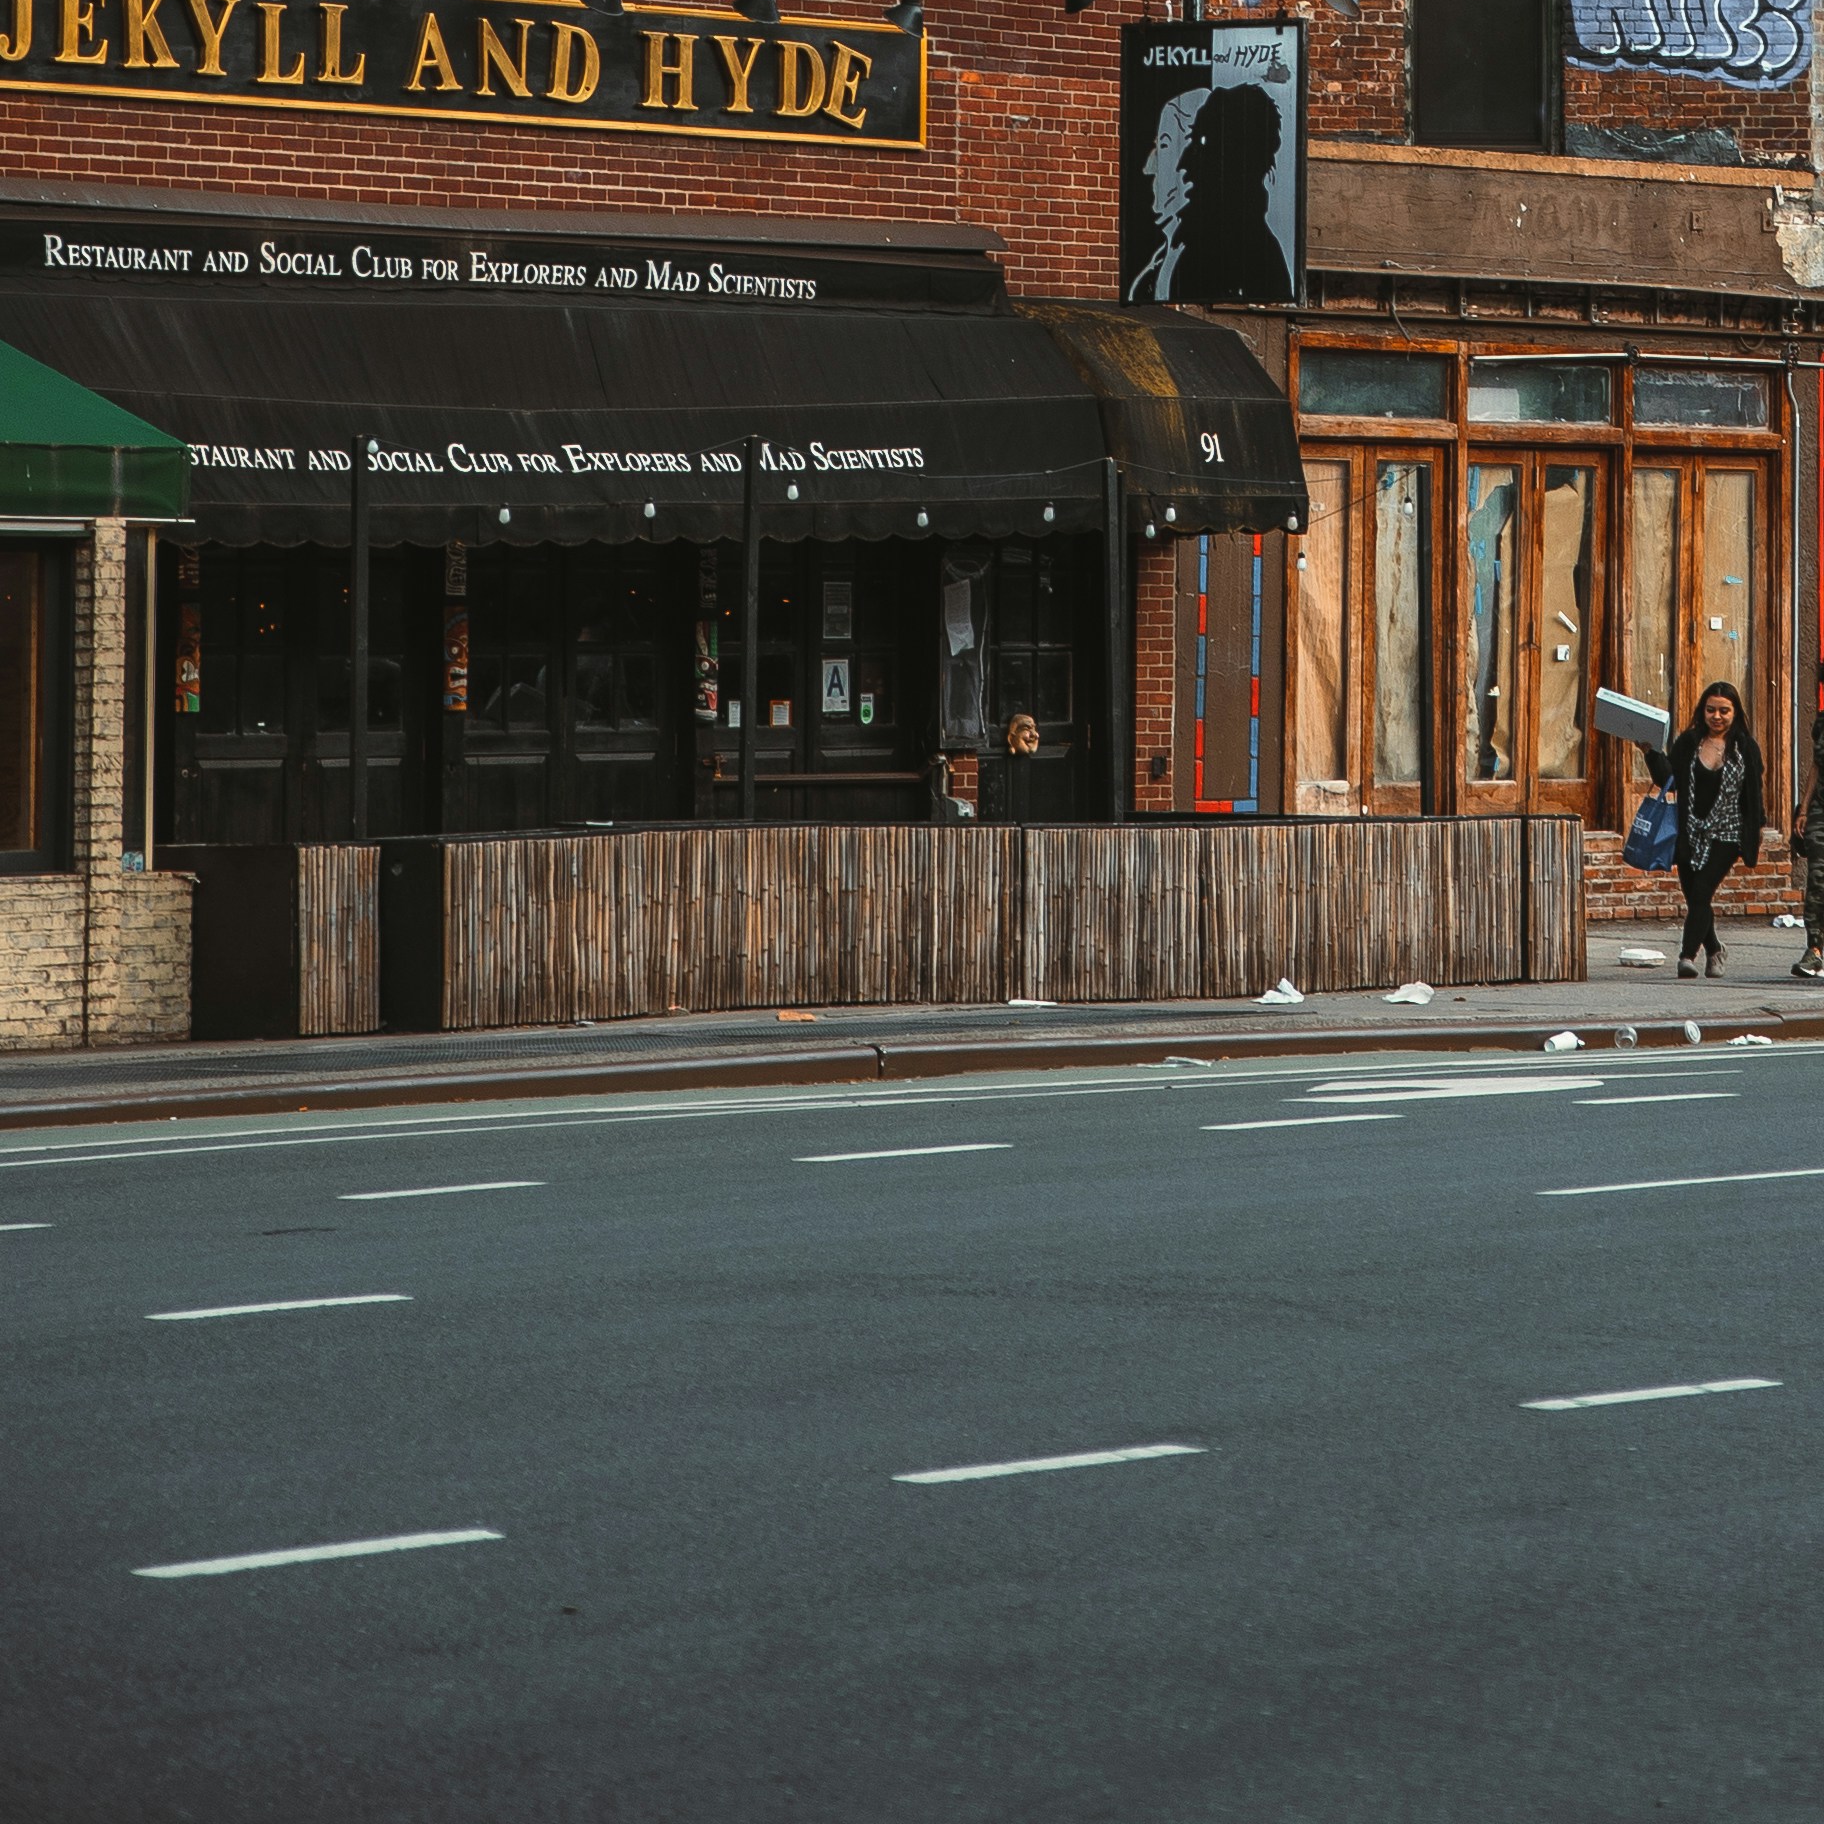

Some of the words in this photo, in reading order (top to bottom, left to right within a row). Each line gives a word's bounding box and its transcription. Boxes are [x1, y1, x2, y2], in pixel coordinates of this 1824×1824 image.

[1143, 46, 1211, 66] JEKYLL
[1213, 47, 1232, 63] and
[1234, 42, 1282, 68] HYDE
[402, 12, 602, 104] AND
[640, 30, 874, 131] HYDE
[203, 249, 249, 274] AND
[259, 241, 342, 276] SOCIAL
[351, 245, 413, 280] CLUB
[421, 258, 459, 282] FOR
[468, 251, 586, 287] EXPLORERS
[595, 266, 638, 290] AND
[644, 259, 700, 292] MAD
[707, 263, 817, 300] SCIENTISTS
[186, 443, 295, 471] STAURANT
[308, 449, 352, 472] AND
[446, 442, 513, 473] CLUB
[520, 453, 562, 474] FOR
[700, 452, 742, 473] AND
[809, 442, 924, 470] SCIENTISTS
[1200, 432, 1224, 464] 91
[826, 665, 845, 697] A
